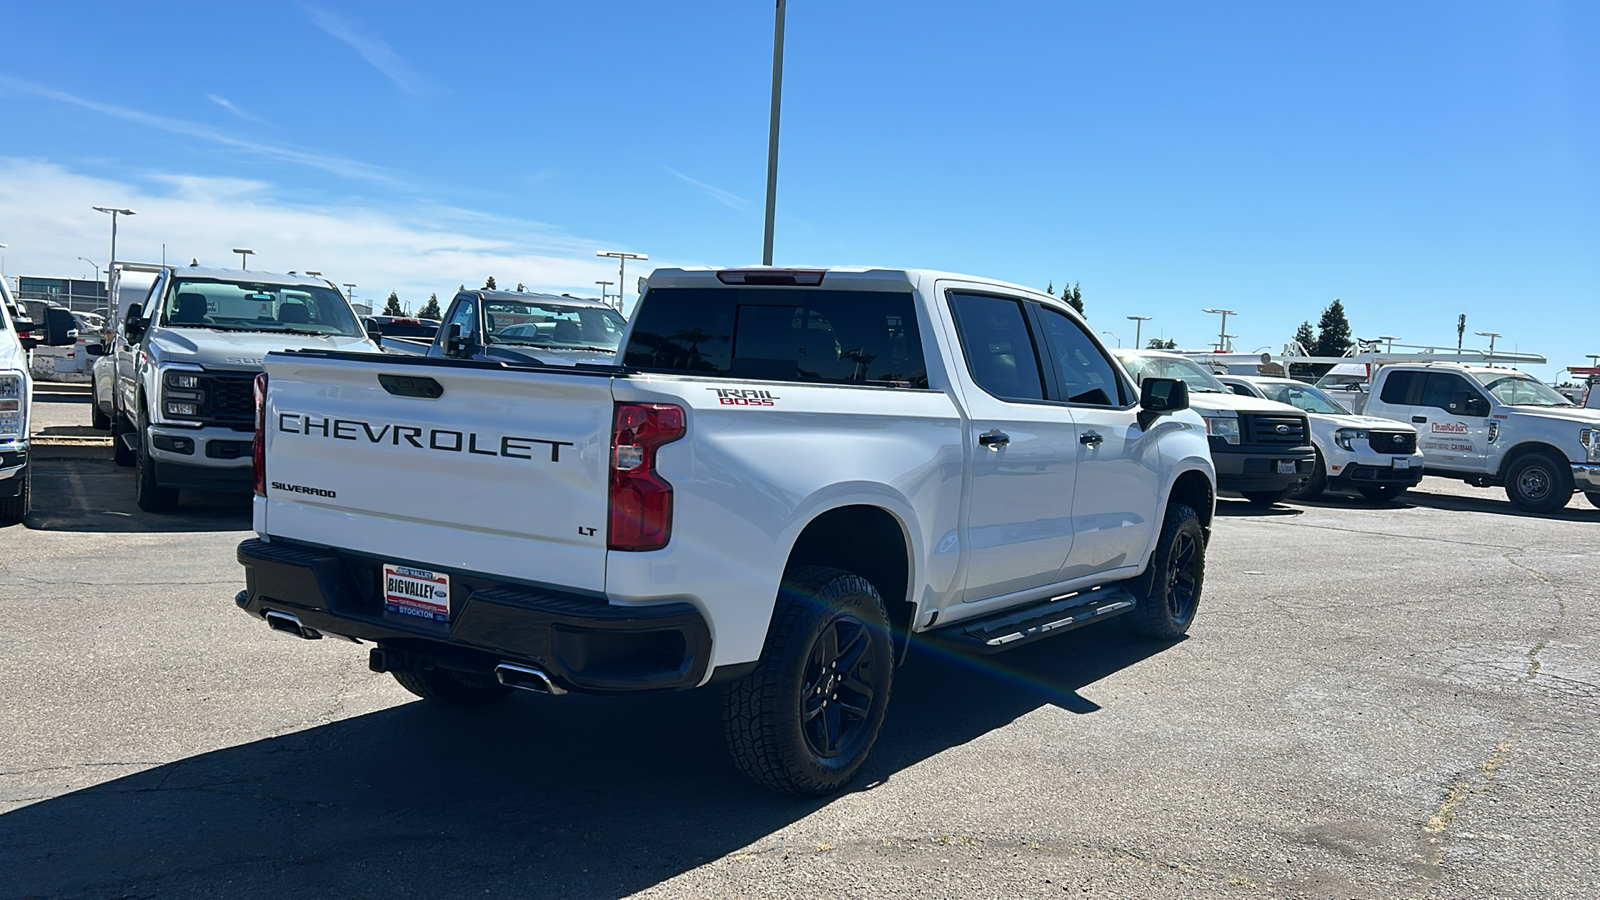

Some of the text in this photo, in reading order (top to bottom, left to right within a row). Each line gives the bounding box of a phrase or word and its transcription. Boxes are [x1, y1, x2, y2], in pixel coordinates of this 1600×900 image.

[706, 388, 781, 399] TRAIL
[719, 397, 774, 406] BOSS
[279, 413, 574, 462] CHEVROLET
[271, 481, 337, 498] SILVERADO
[578, 526, 598, 537] LT
[410, 570, 432, 579] VALLEY
[388, 578, 435, 599] BIGVALLEY
[399, 606, 434, 619] STOCKTON
